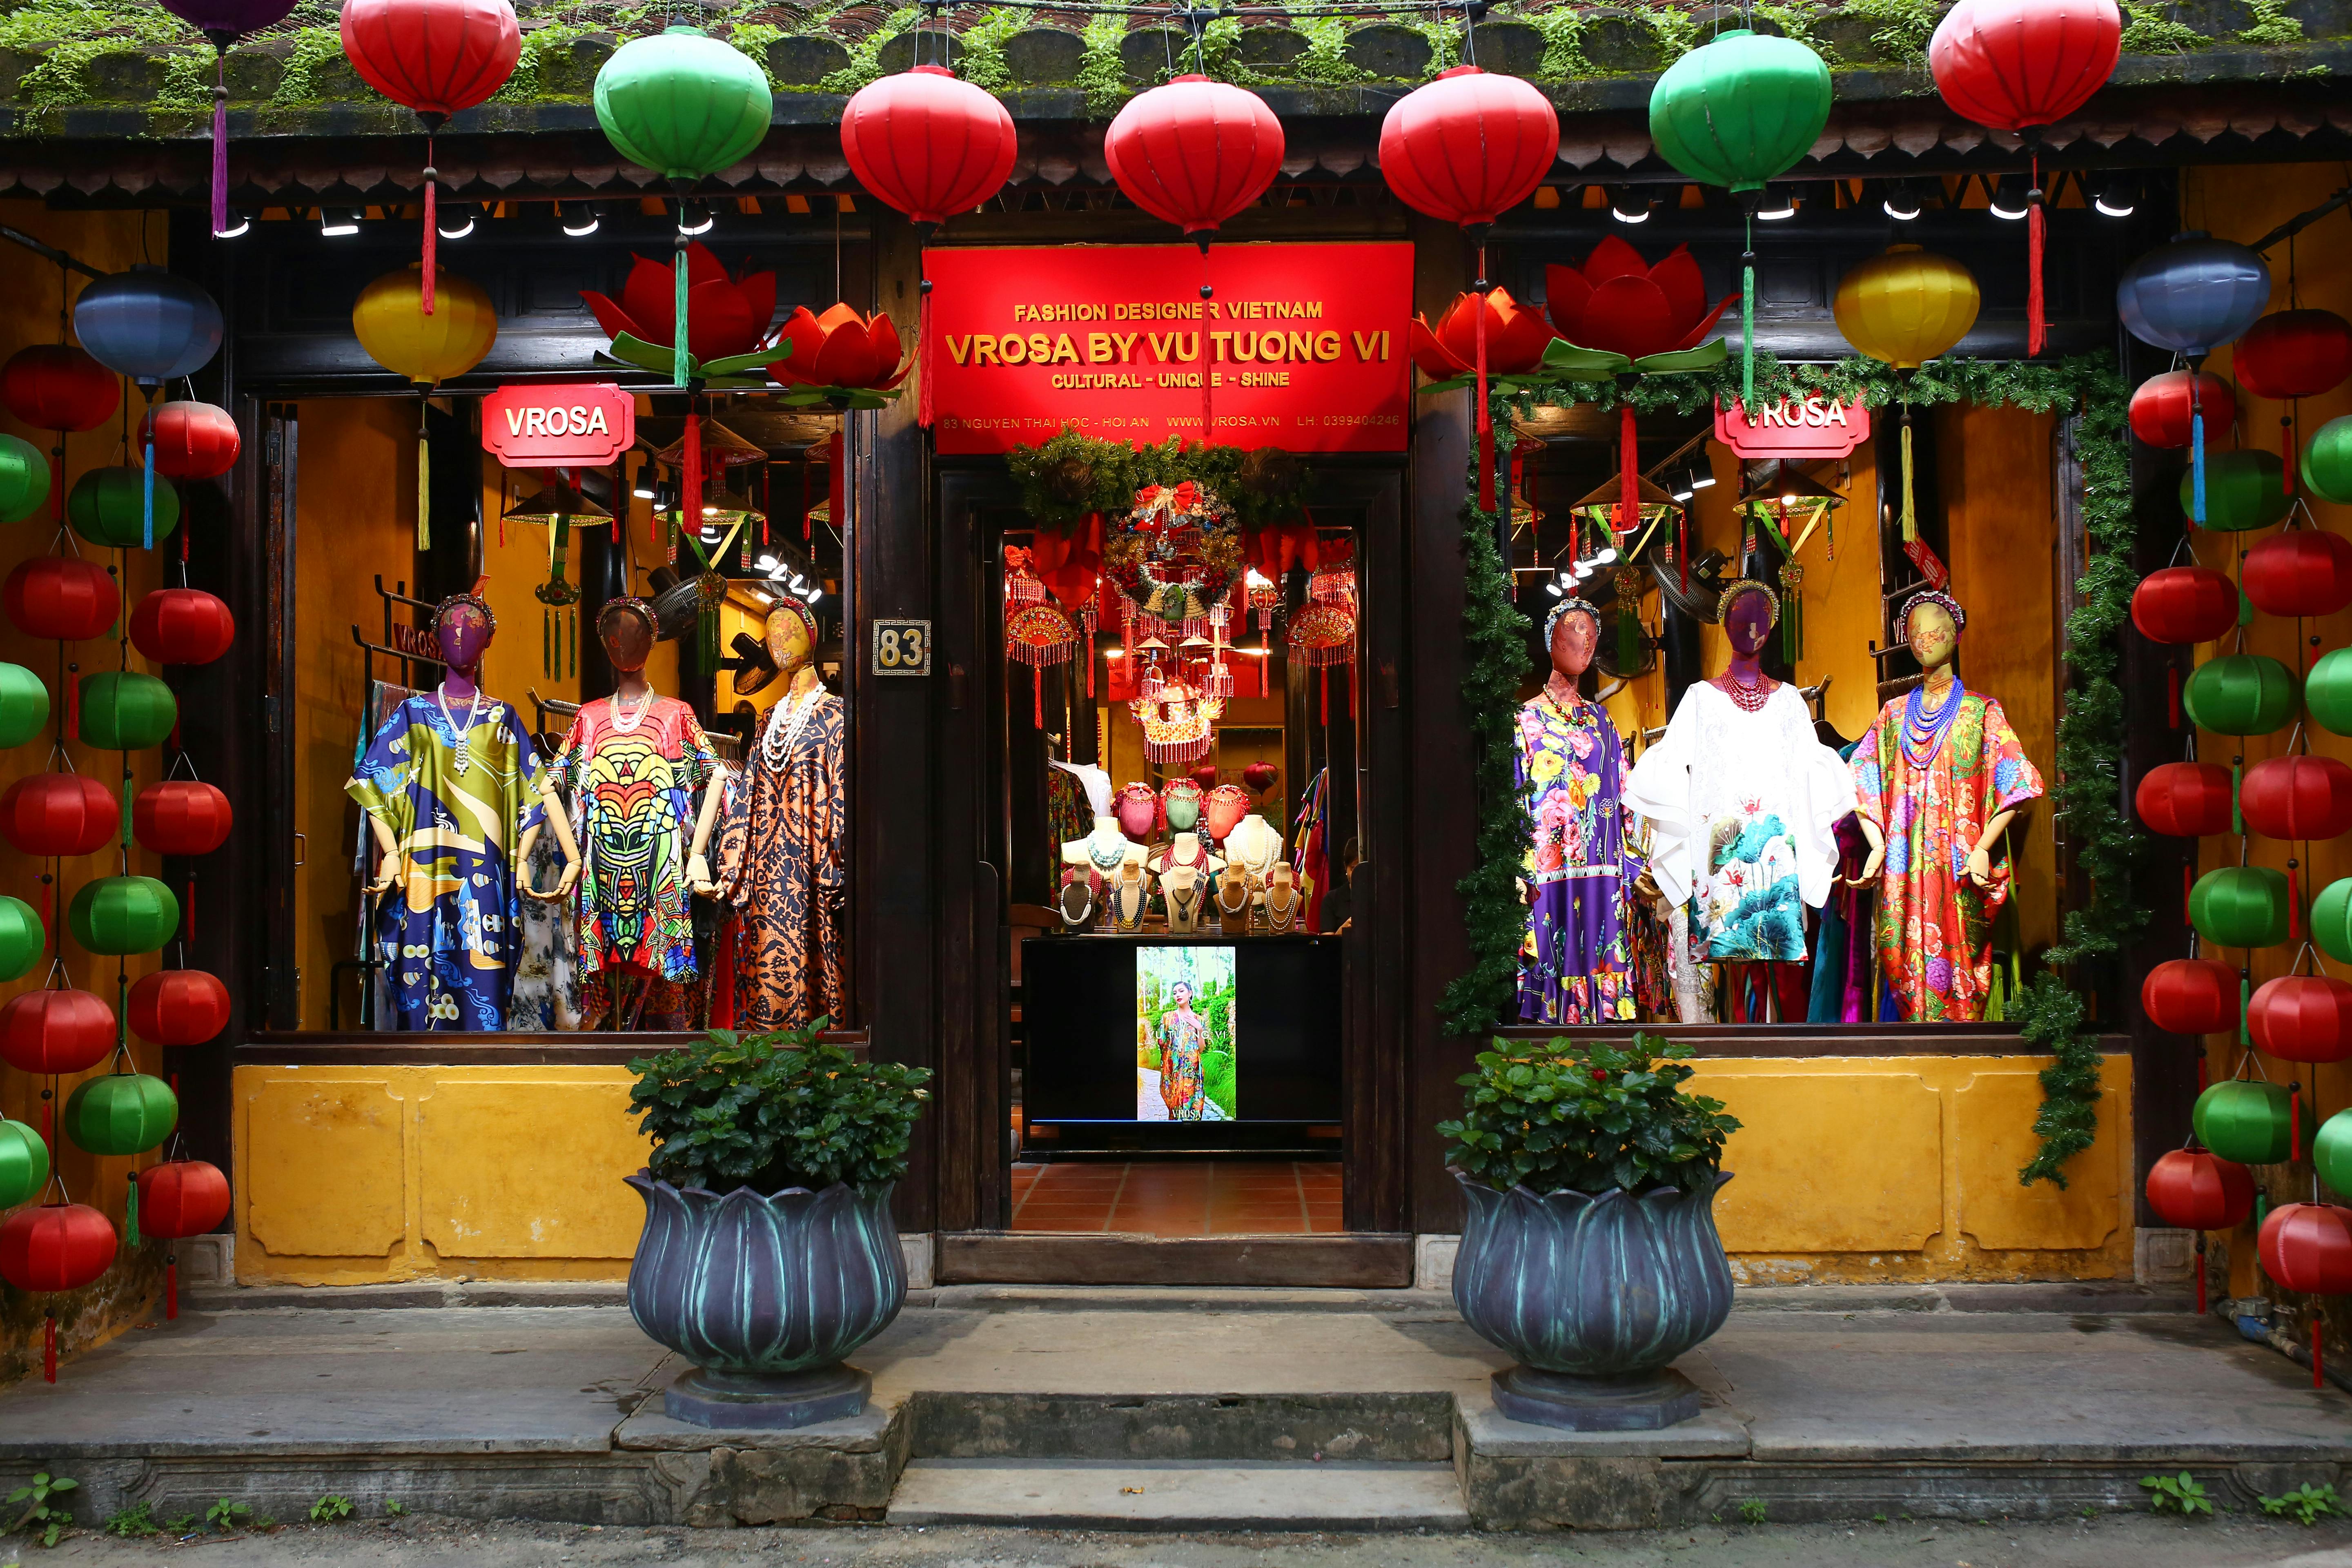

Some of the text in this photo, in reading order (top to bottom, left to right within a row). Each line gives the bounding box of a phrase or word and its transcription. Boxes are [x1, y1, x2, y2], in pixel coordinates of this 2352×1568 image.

[1014, 301, 1322, 321] FASHION DESIGNER VIETNAM
[945, 330, 1389, 363] VROSA BY VU TUONG VI
[1052, 374, 1142, 388] CULTURAL
[1158, 372, 1222, 387] UNIQE
[1241, 372, 1290, 386] SHINE
[505, 405, 609, 436] VROSA
[944, 419, 958, 429] 83
[962, 418, 1020, 429] NGUYEN
[1024, 418, 1056, 428] THAI
[1060, 417, 1089, 428] HOC
[1102, 417, 1126, 427] HOI
[1129, 417, 1149, 427] AN
[1167, 416, 1280, 426] WWWVROSA.VN
[1297, 415, 1399, 426] LH: 0399404246
[880, 628, 923, 666] 83
[1147, 1030, 1225, 1039] VU TUONG VI
[1172, 1109, 1201, 1118] VROSA
